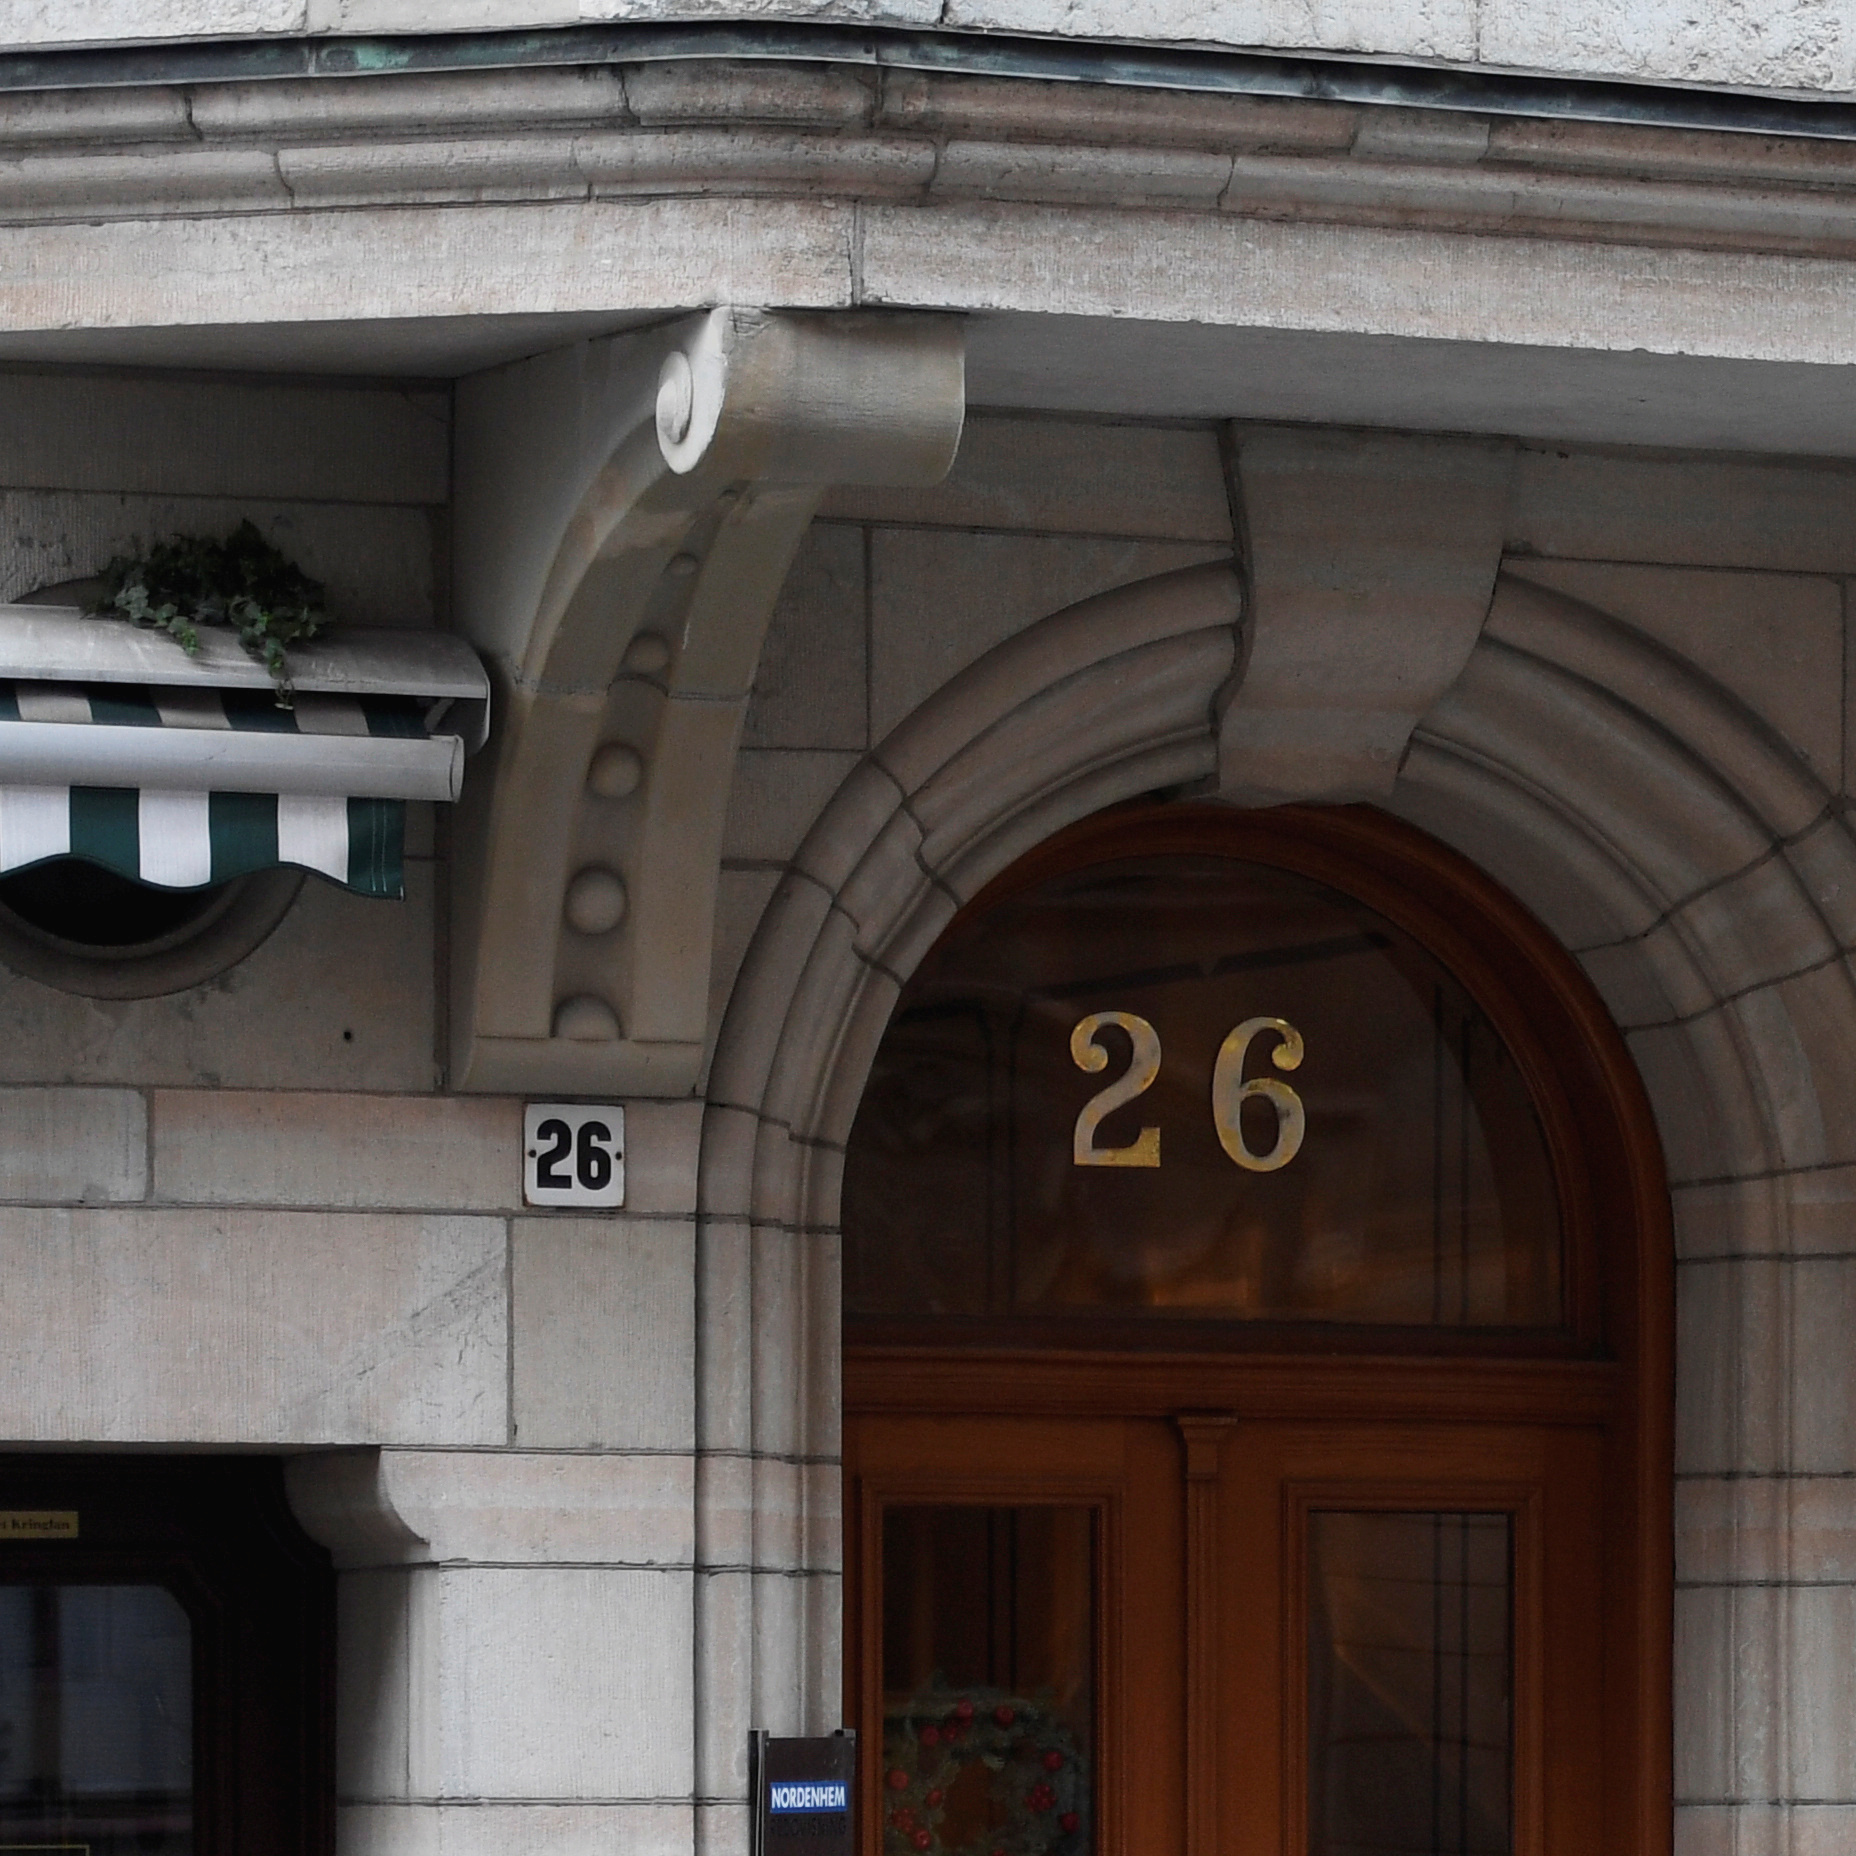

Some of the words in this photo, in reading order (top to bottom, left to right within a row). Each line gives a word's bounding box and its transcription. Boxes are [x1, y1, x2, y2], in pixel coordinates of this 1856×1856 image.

[1069, 1010, 1307, 1173] 26
[534, 1118, 613, 1191] 26
[771, 1785, 846, 1809] NORDENHEM
